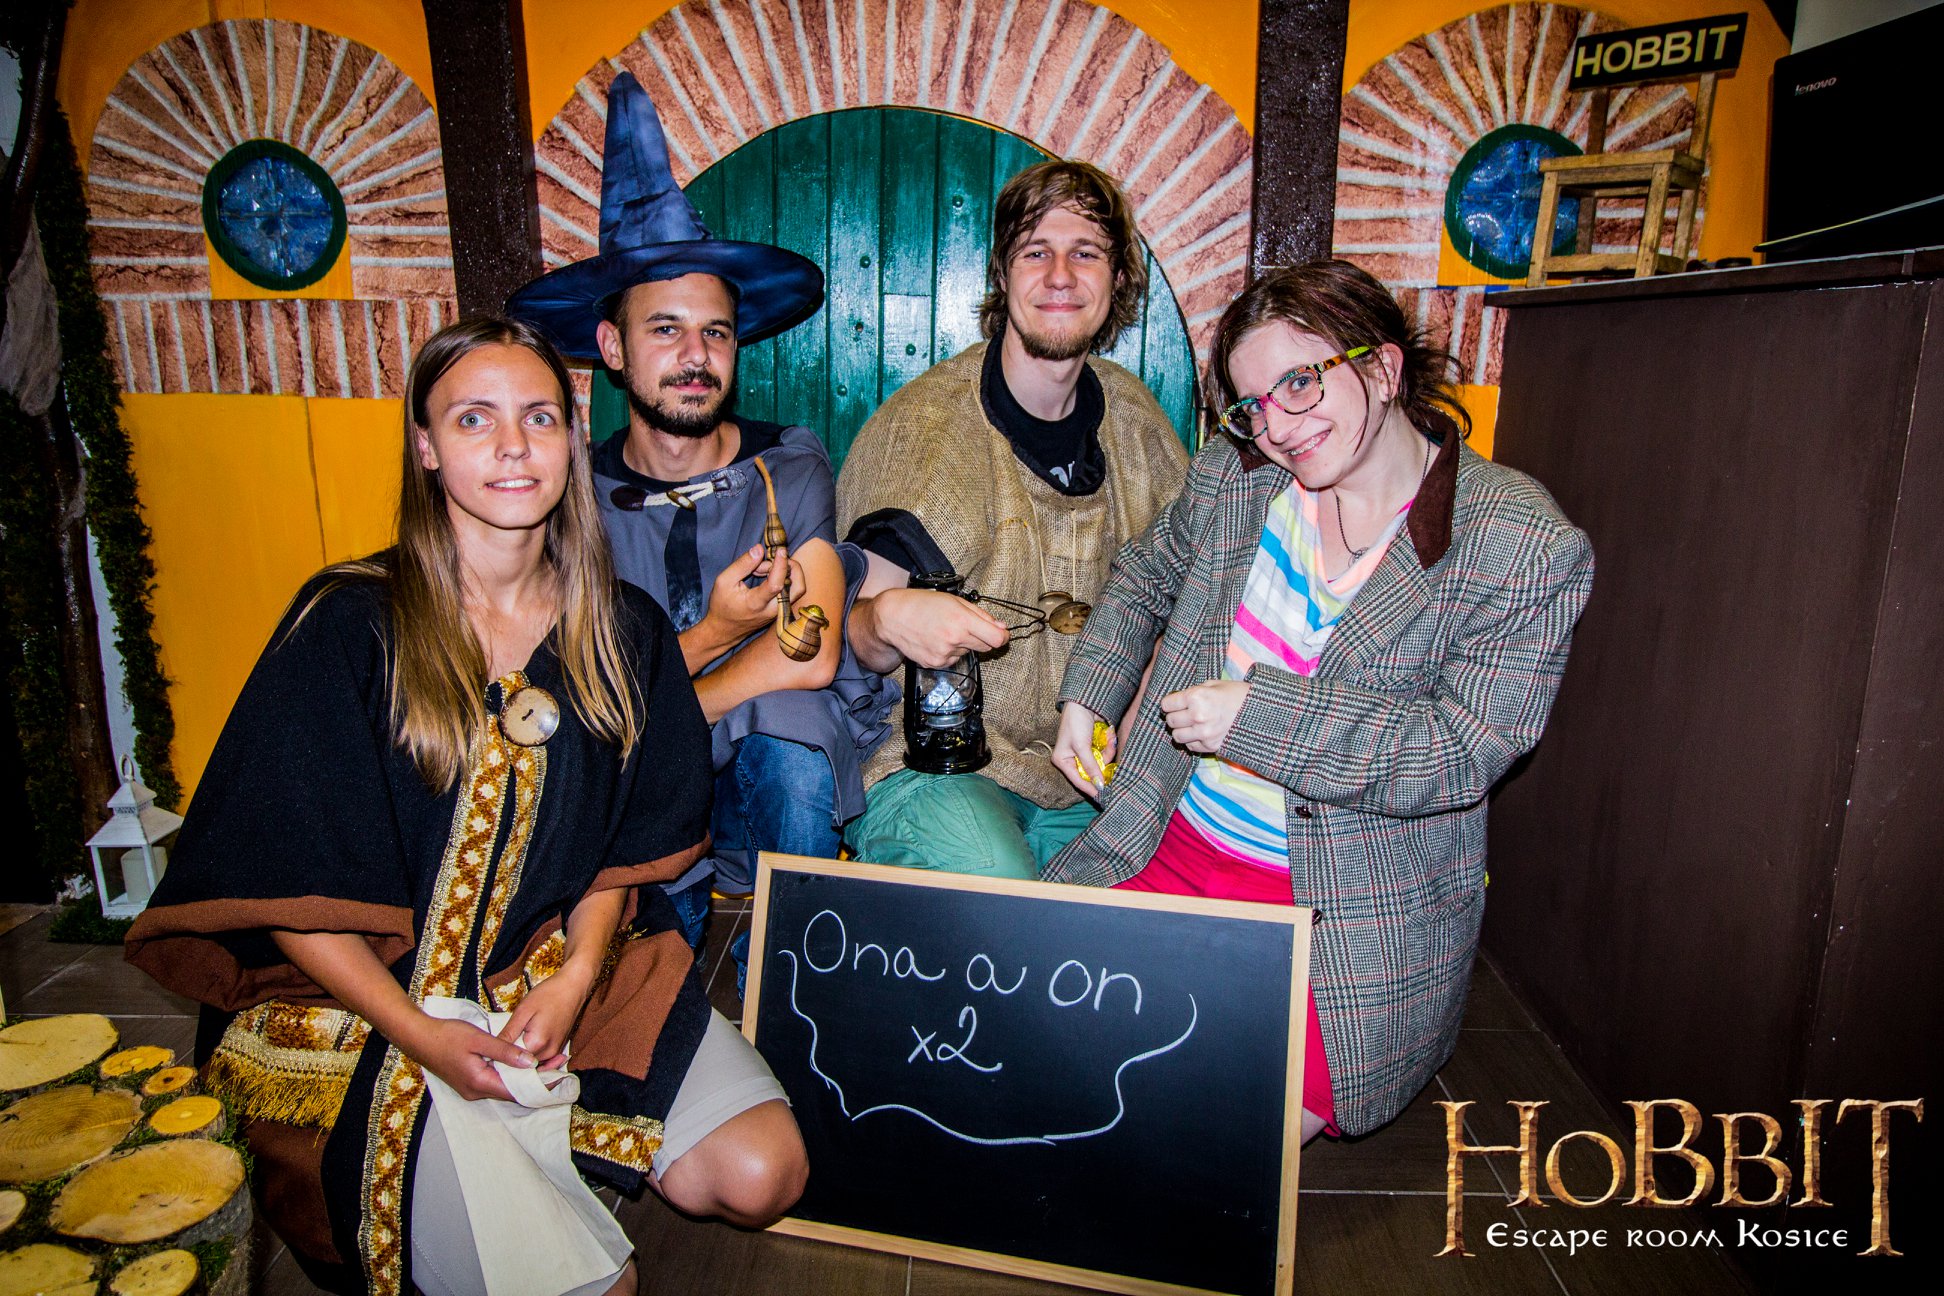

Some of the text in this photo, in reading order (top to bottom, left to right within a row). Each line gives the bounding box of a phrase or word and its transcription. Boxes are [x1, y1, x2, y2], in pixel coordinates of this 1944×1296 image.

[1575, 24, 1739, 78] HOBBIT
[1795, 77, 1838, 96] lenovo
[803, 909, 946, 982] Ona
[966, 953, 1027, 995] a
[907, 1003, 1003, 1072] x2
